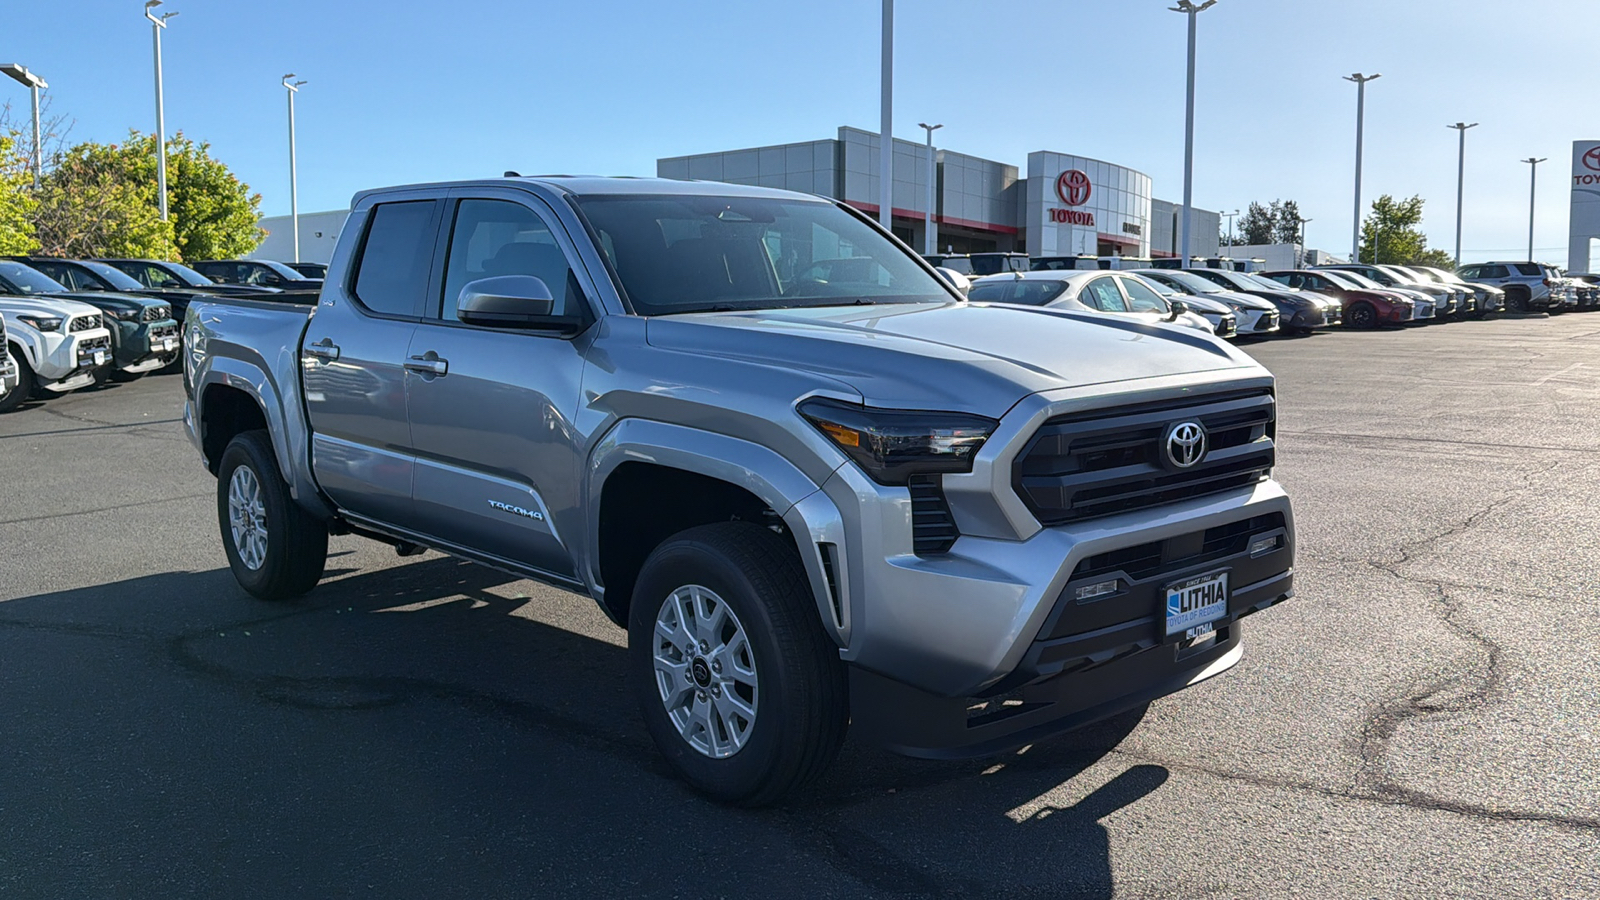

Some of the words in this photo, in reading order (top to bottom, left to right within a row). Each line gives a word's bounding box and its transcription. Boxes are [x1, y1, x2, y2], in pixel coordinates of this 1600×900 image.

[1048, 208, 1095, 226] TOYOTA
[488, 500, 543, 520] TACOMA
[1180, 581, 1225, 613] LITHIA
[1190, 611, 1198, 620] OF
[1199, 603, 1225, 617] REDDING
[1193, 621, 1213, 637] LITHIA
